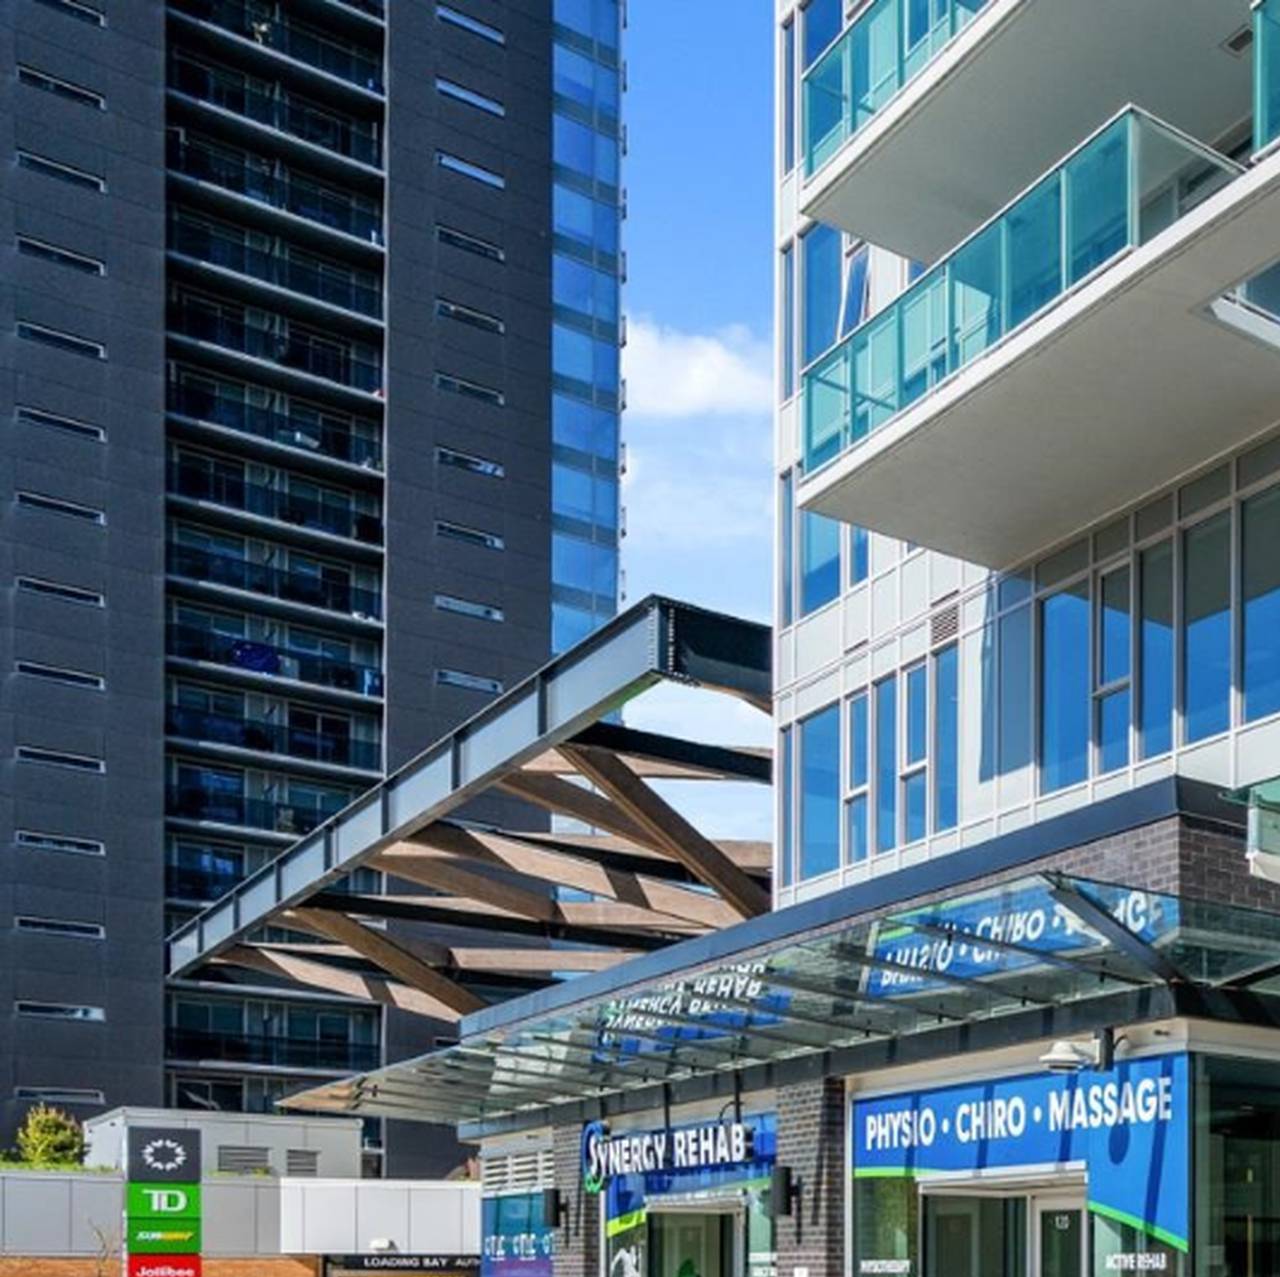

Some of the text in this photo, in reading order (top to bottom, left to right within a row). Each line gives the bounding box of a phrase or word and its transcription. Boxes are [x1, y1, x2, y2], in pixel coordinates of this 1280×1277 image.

[865, 1076, 1173, 1151] PHYSIO CHIRO MASSAGE
[589, 1122, 746, 1177] SYNERGY REHAB
[141, 1189, 188, 1212] TD
[136, 1266, 195, 1277] Jollibee
[364, 1257, 420, 1268] LOADING
[423, 1257, 448, 1267] BAY
